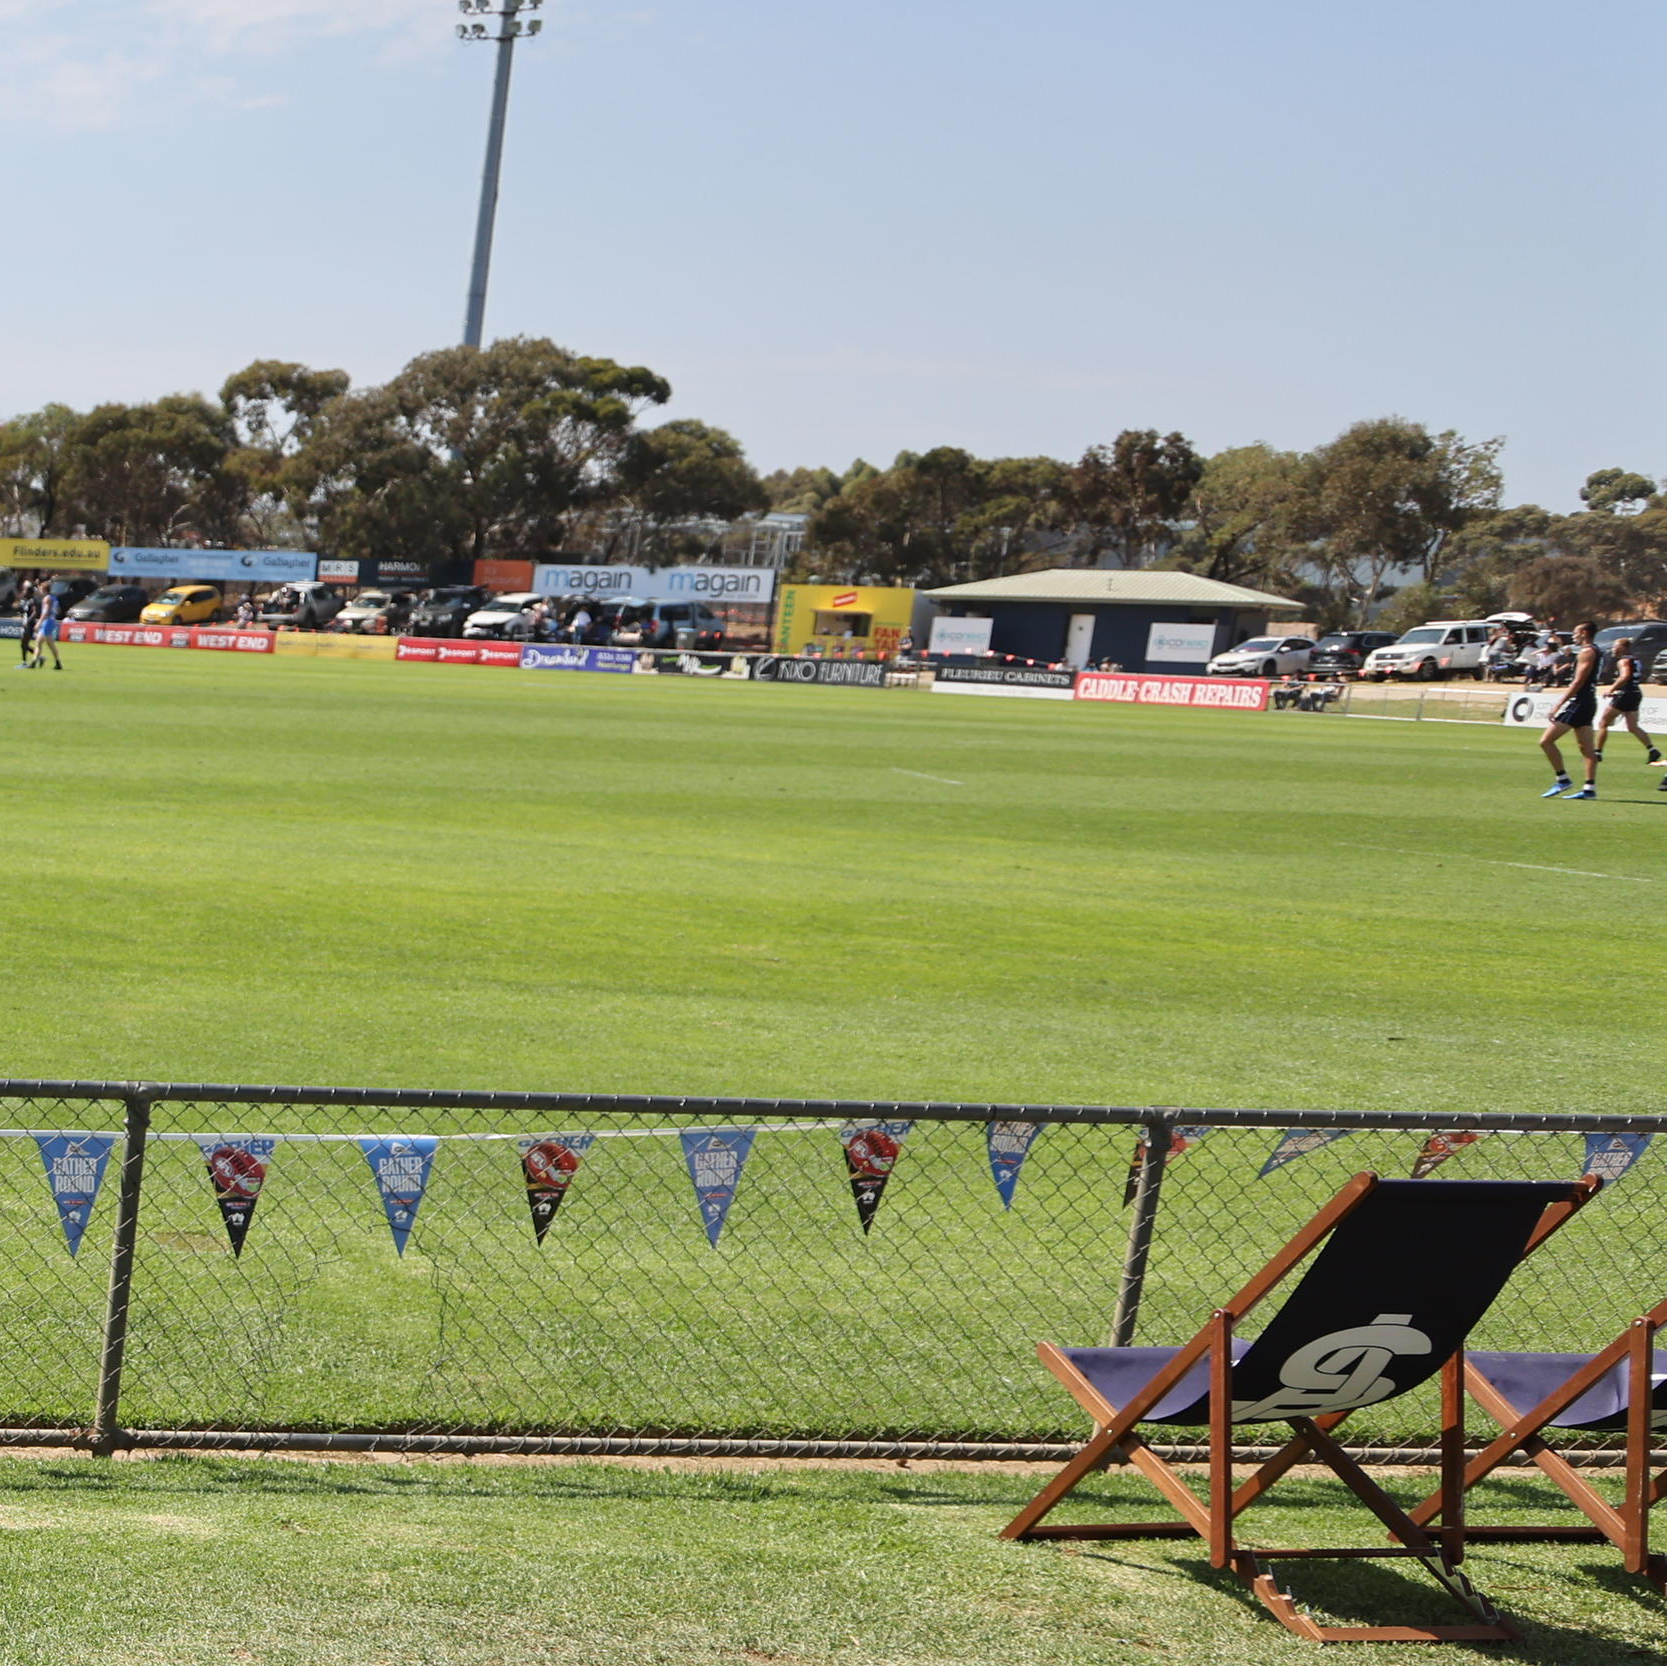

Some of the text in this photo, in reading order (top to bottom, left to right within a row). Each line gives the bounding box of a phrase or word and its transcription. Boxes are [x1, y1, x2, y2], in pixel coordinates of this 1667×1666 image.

[13, 545, 101, 560] Flinders.edu.au
[544, 569, 633, 592] magain
[668, 571, 761, 595] magain
[94, 627, 164, 645] WEST END
[197, 634, 268, 652] WEST END
[819, 663, 883, 686] FURNITURE
[941, 668, 1070, 686] FLEURIEU CABINETS
[1078, 675, 1264, 708] CADDLE CRASH REPAIRS
[54, 1157, 97, 1176] GATHER
[378, 1157, 423, 1175] GATHER
